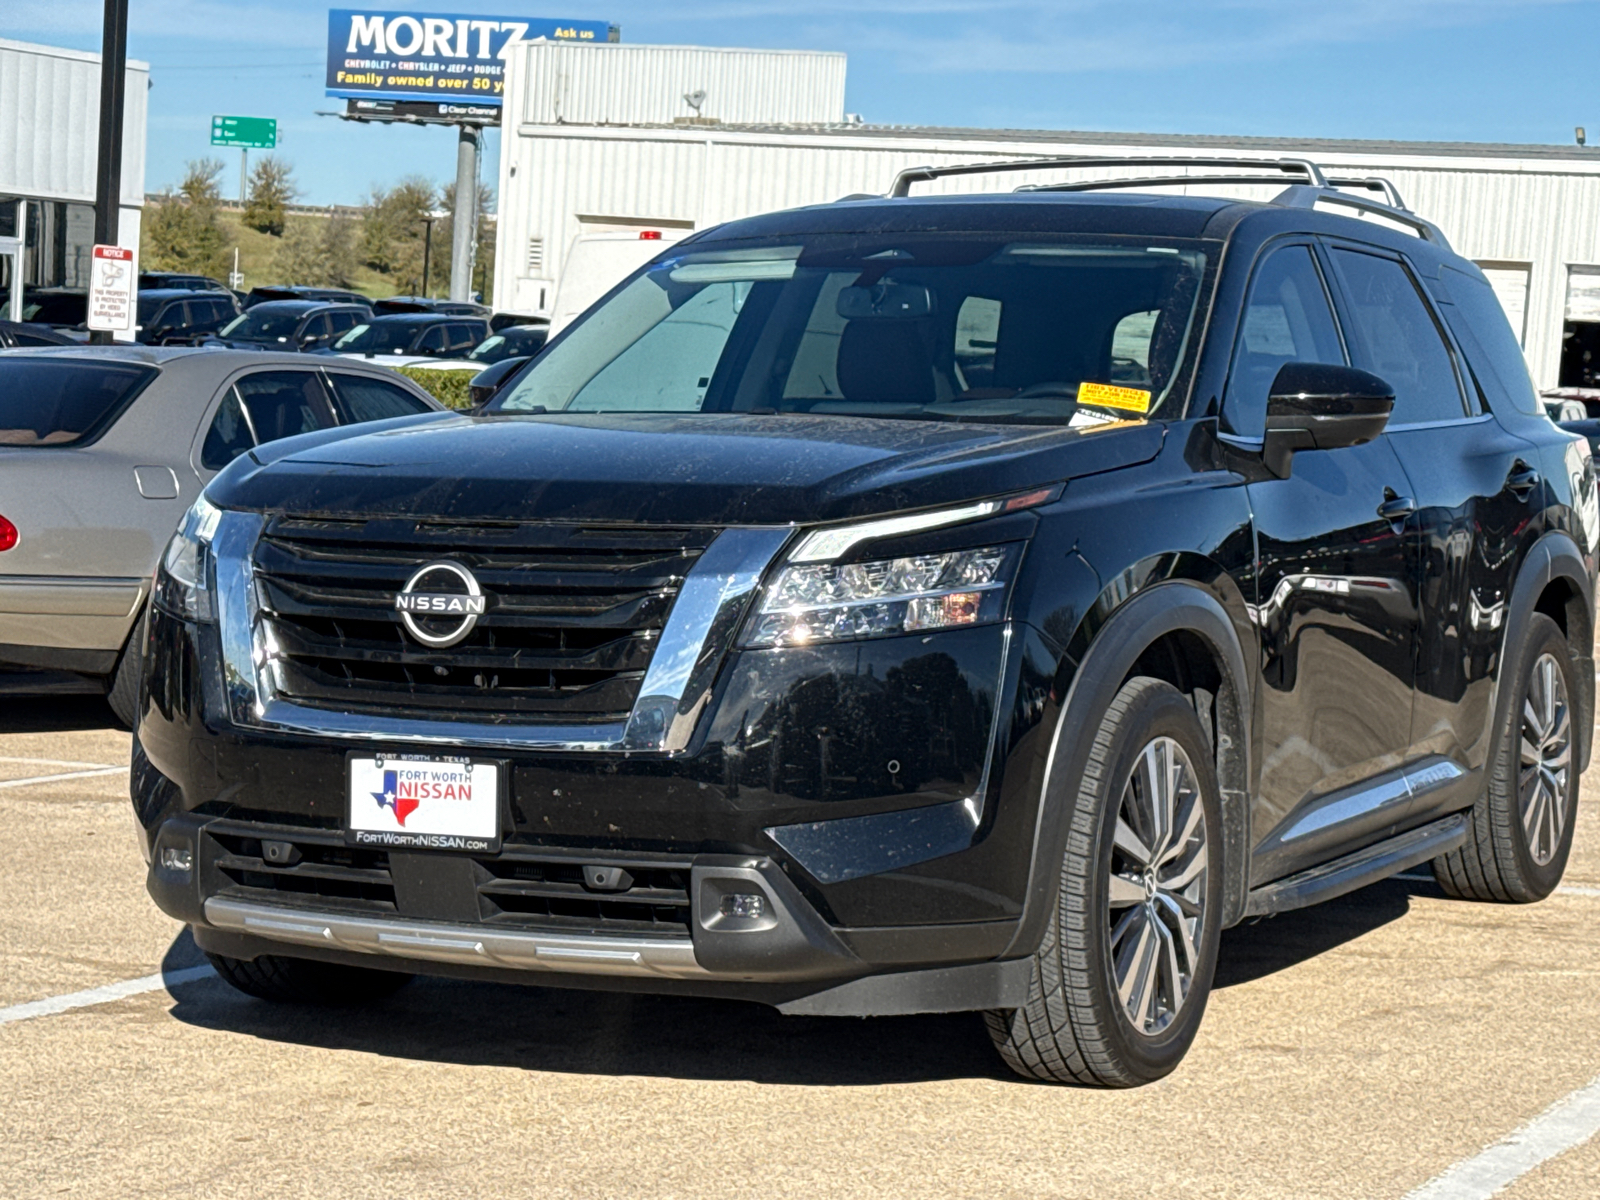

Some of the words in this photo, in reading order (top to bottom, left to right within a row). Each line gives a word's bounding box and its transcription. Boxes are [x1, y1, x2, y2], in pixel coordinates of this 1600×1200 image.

[346, 15, 529, 60] MORITZ
[554, 27, 577, 38] Ask
[580, 31, 595, 39] us
[344, 59, 390, 70] CHEVROLET
[398, 61, 440, 72] CHRYSLER
[447, 64, 466, 73] JEEP
[474, 65, 501, 75] DODGE
[337, 71, 383, 87] Family
[387, 75, 434, 87] owned
[438, 78, 469, 89] over
[472, 77, 490, 90] 50
[103, 249, 124, 258] NOTICE
[1108, 387, 1145, 396] VEHICLE
[396, 595, 482, 612] NISSAN
[443, 755, 470, 764] TEXAS
[400, 770, 428, 781] FORT
[431, 771, 472, 783] WORTH
[400, 781, 472, 801] NISSAN
